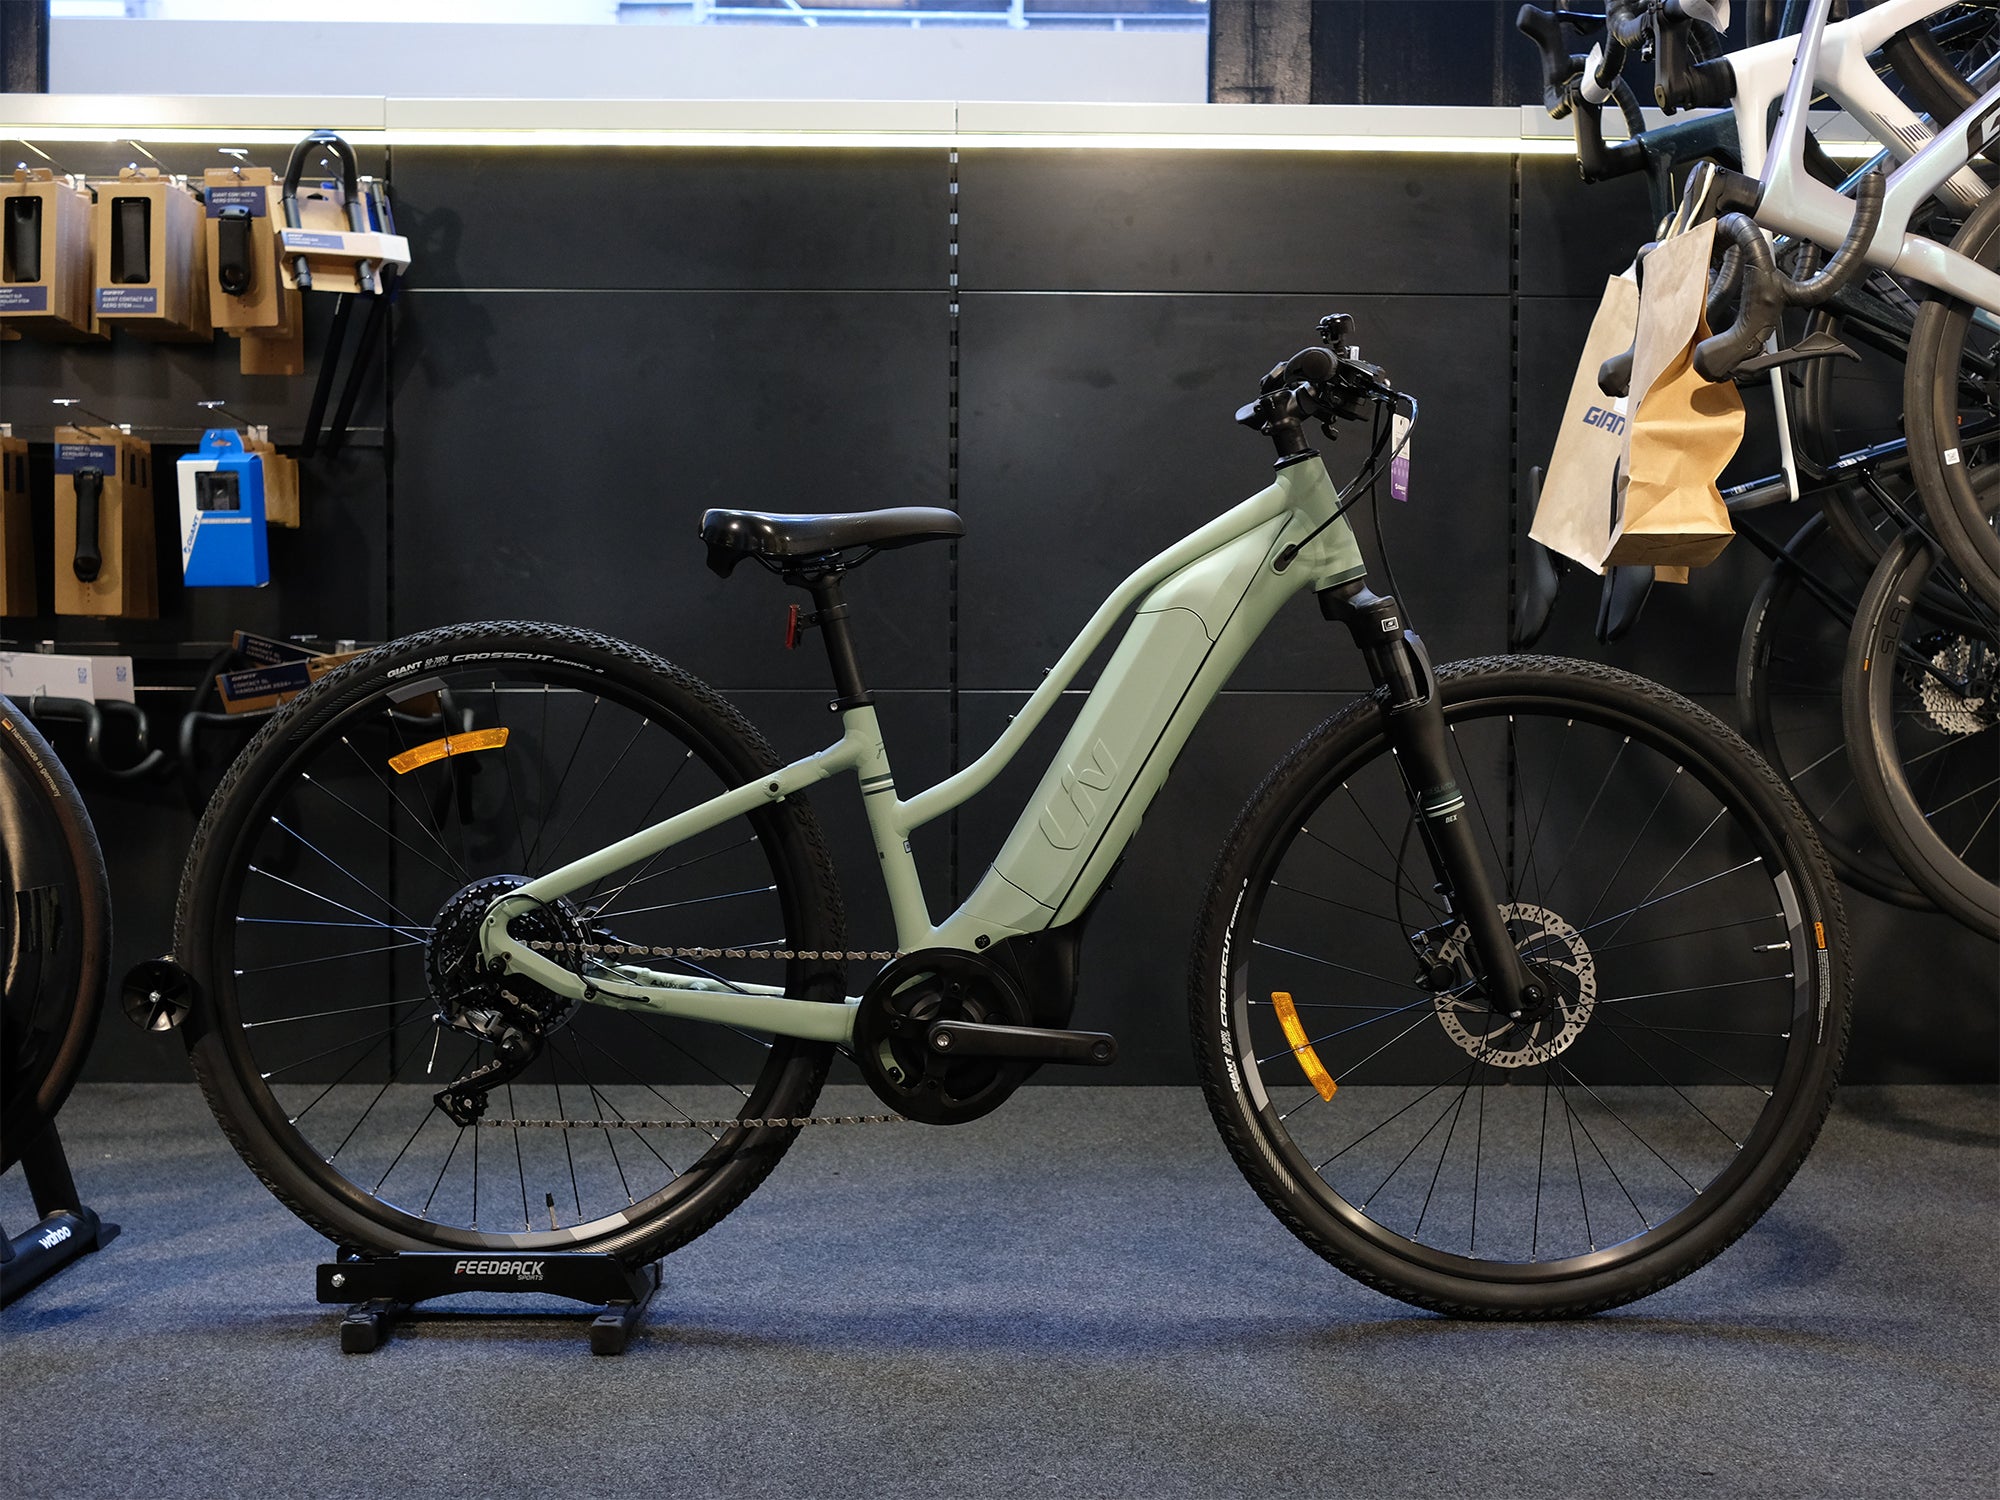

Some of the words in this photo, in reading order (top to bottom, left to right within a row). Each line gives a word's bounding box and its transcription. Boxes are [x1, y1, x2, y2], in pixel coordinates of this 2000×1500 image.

[1583, 406, 1626, 436] GIAN
[187, 514, 199, 546] GIANT
[1881, 607, 1906, 654] SLR
[387, 660, 423, 678] GIANT
[452, 652, 554, 663] CROSSCUT
[11, 728, 39, 762] handmade
[36, 761, 44, 769] in
[40, 768, 61, 797] germany
[1220, 926, 1231, 1028] CROSSCUT
[1225, 1056, 1240, 1092] GIANT
[38, 1226, 72, 1249] wahoo
[454, 1261, 545, 1275] FEEDBACK
